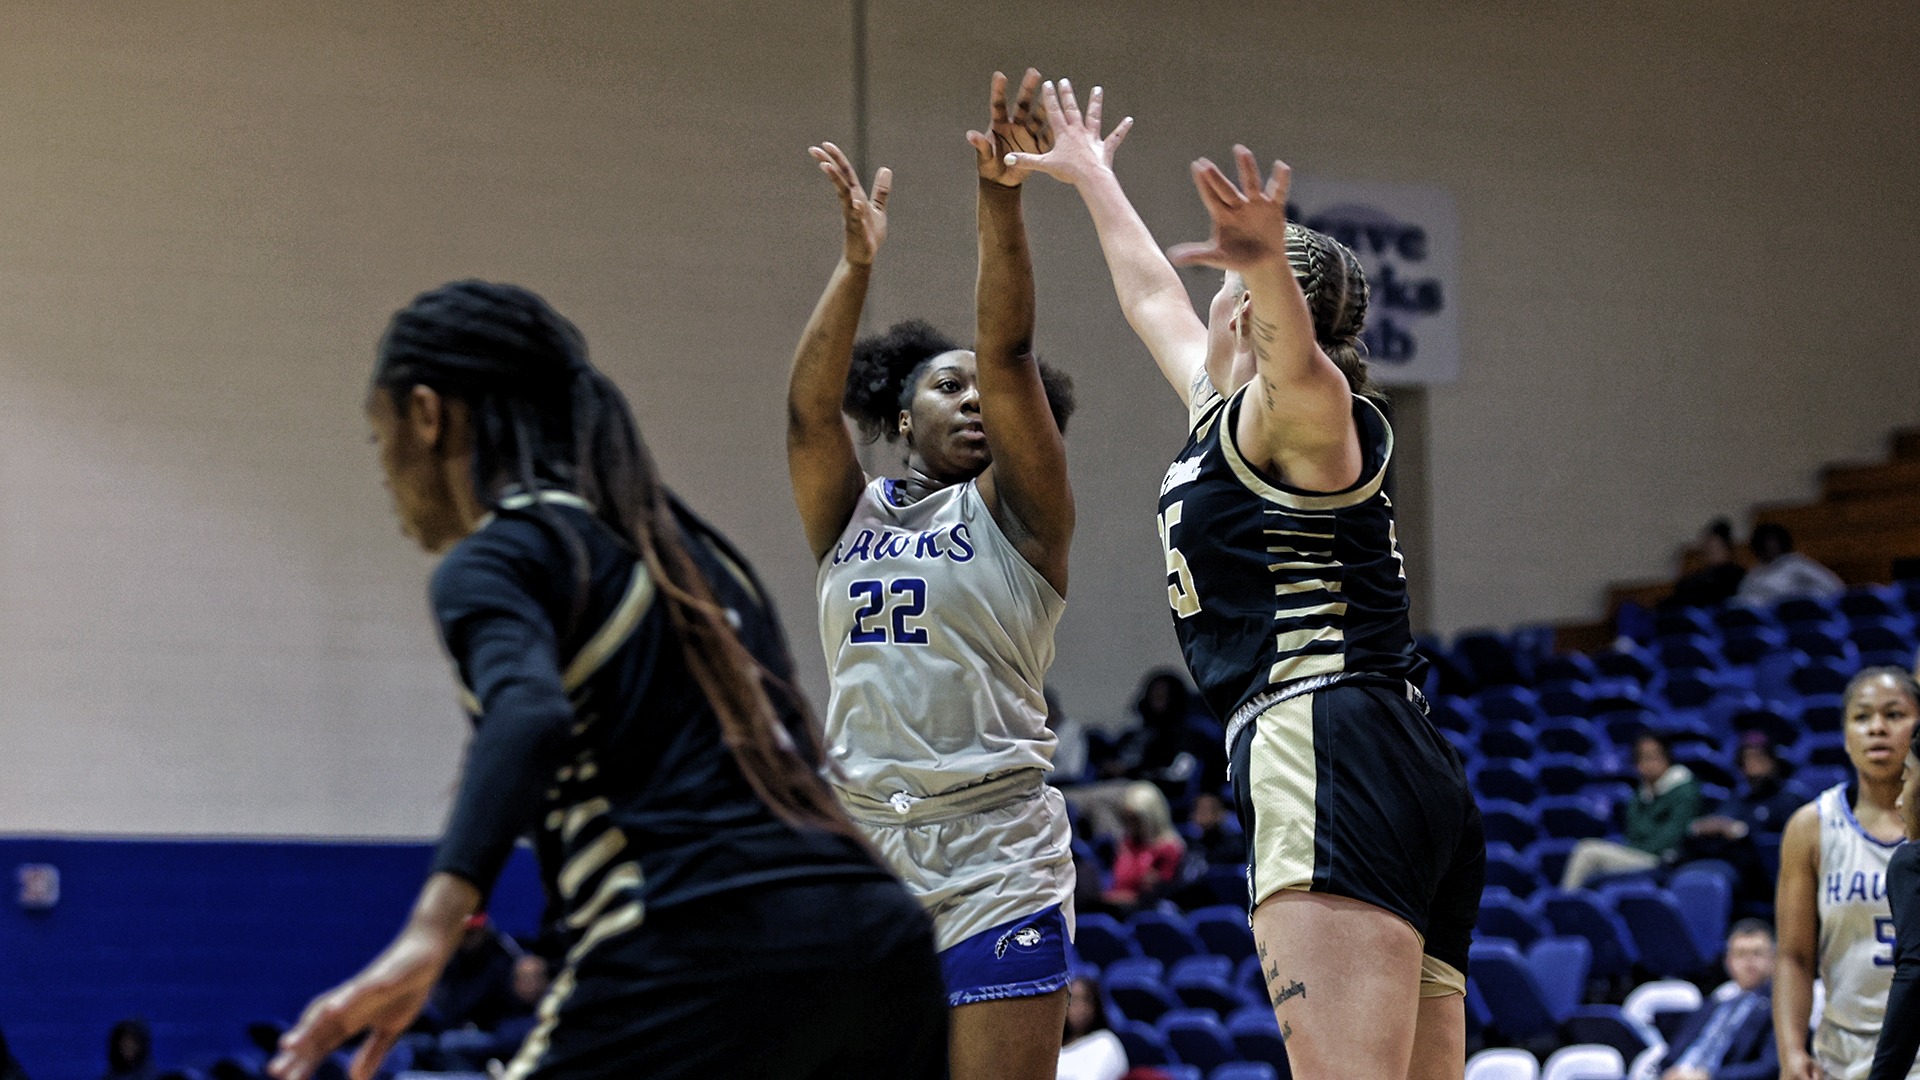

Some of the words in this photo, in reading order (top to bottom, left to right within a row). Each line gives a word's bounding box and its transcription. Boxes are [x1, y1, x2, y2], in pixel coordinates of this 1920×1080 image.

[1157, 500, 1202, 619] 5
[849, 577, 929, 645] 22
[1872, 915, 1897, 966] 5
